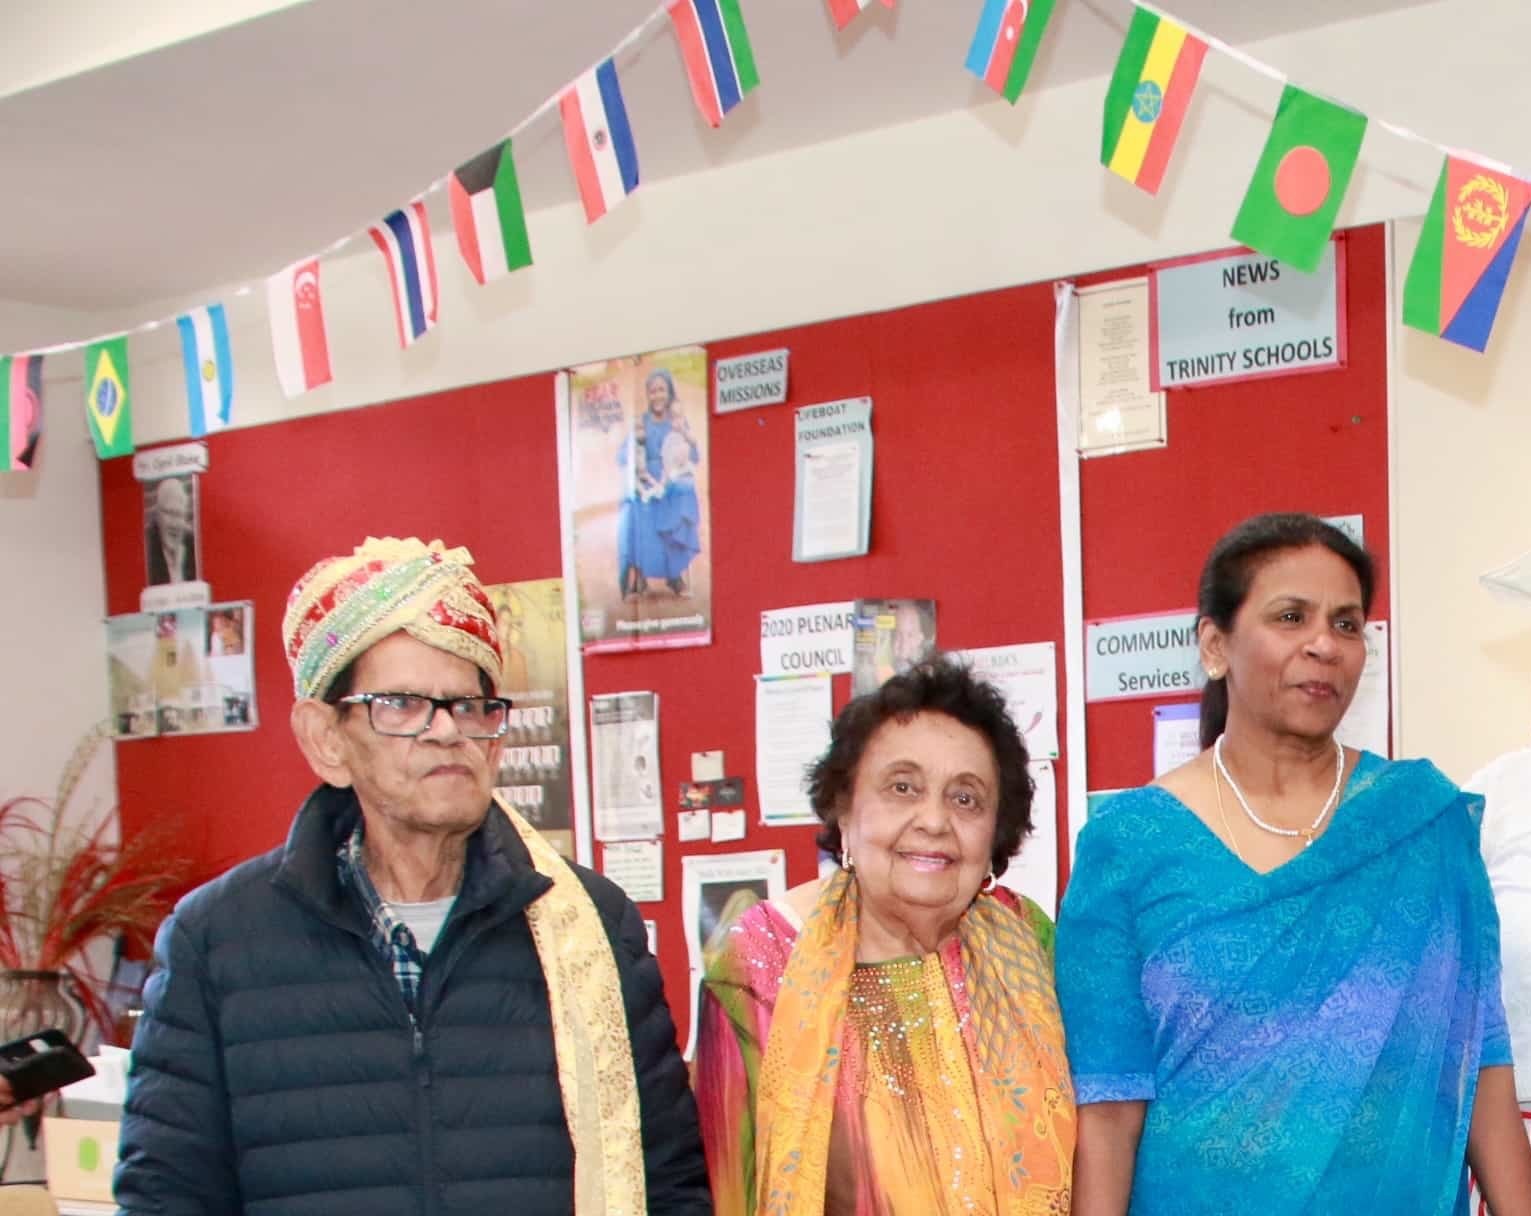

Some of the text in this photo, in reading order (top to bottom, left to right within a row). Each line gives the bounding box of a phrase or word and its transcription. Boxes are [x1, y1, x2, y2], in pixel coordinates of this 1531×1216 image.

[1222, 259, 1281, 288] NEWS
[1228, 307, 1275, 329] from
[717, 355, 784, 382] OVERSEAS
[1166, 336, 1333, 381] TRINITY SCHOOLS
[719, 382, 782, 405] MISSIONS
[797, 403, 848, 422] LIFEBOAT
[798, 420, 866, 442] FOUNDATION
[762, 616, 793, 638] 2020
[798, 612, 855, 634] PLENAR
[1096, 628, 1199, 656] COMMUNI
[780, 647, 845, 670] COUNCIL
[1118, 668, 1190, 692] Services
